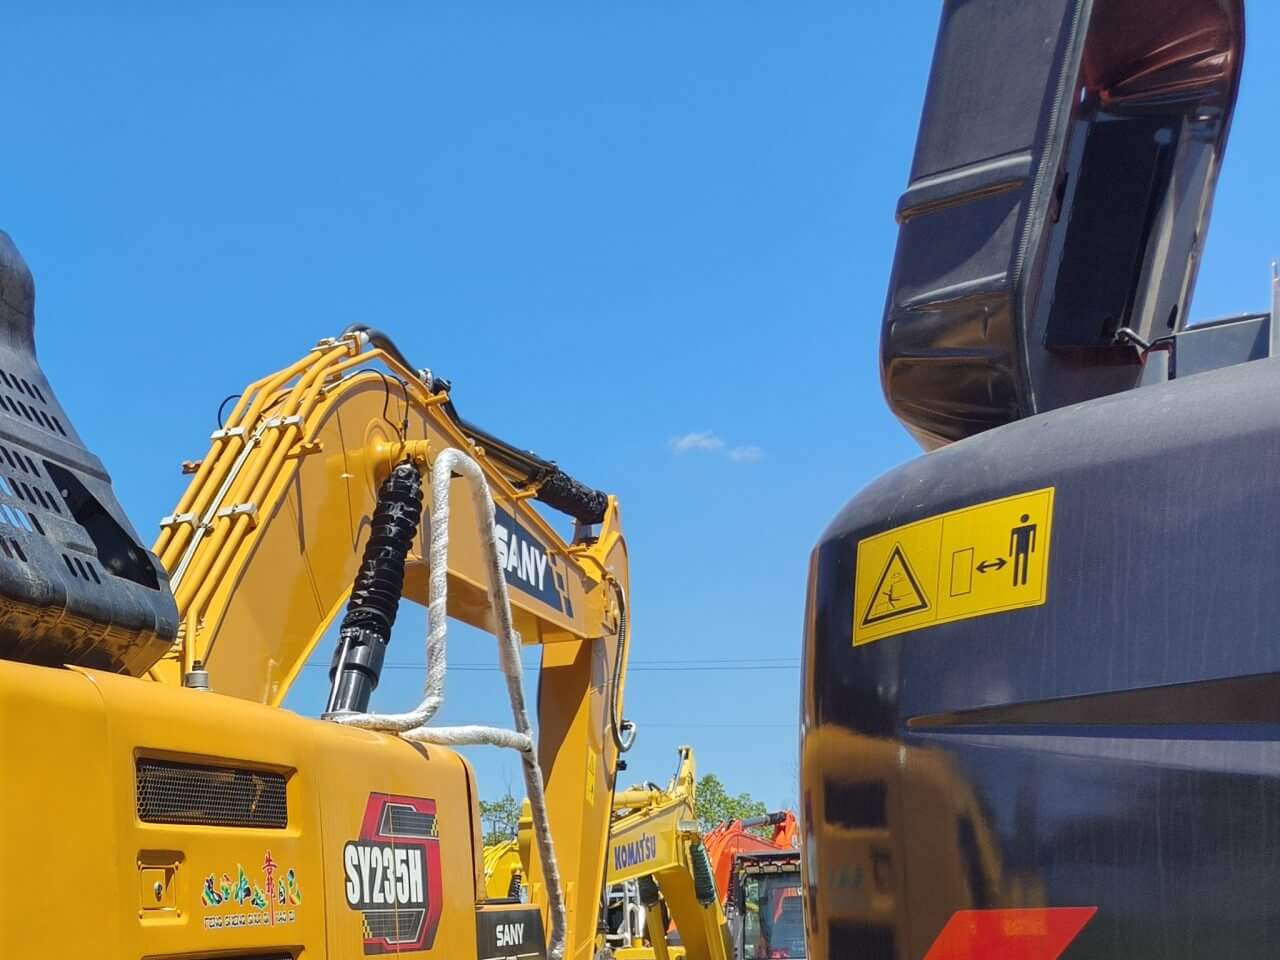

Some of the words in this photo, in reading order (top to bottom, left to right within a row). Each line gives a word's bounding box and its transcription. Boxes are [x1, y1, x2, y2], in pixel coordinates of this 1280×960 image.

[495, 524, 547, 591] SANY
[344, 844, 424, 905] SY235H
[614, 832, 656, 871] KOMATSU
[496, 923, 524, 947] SANY
